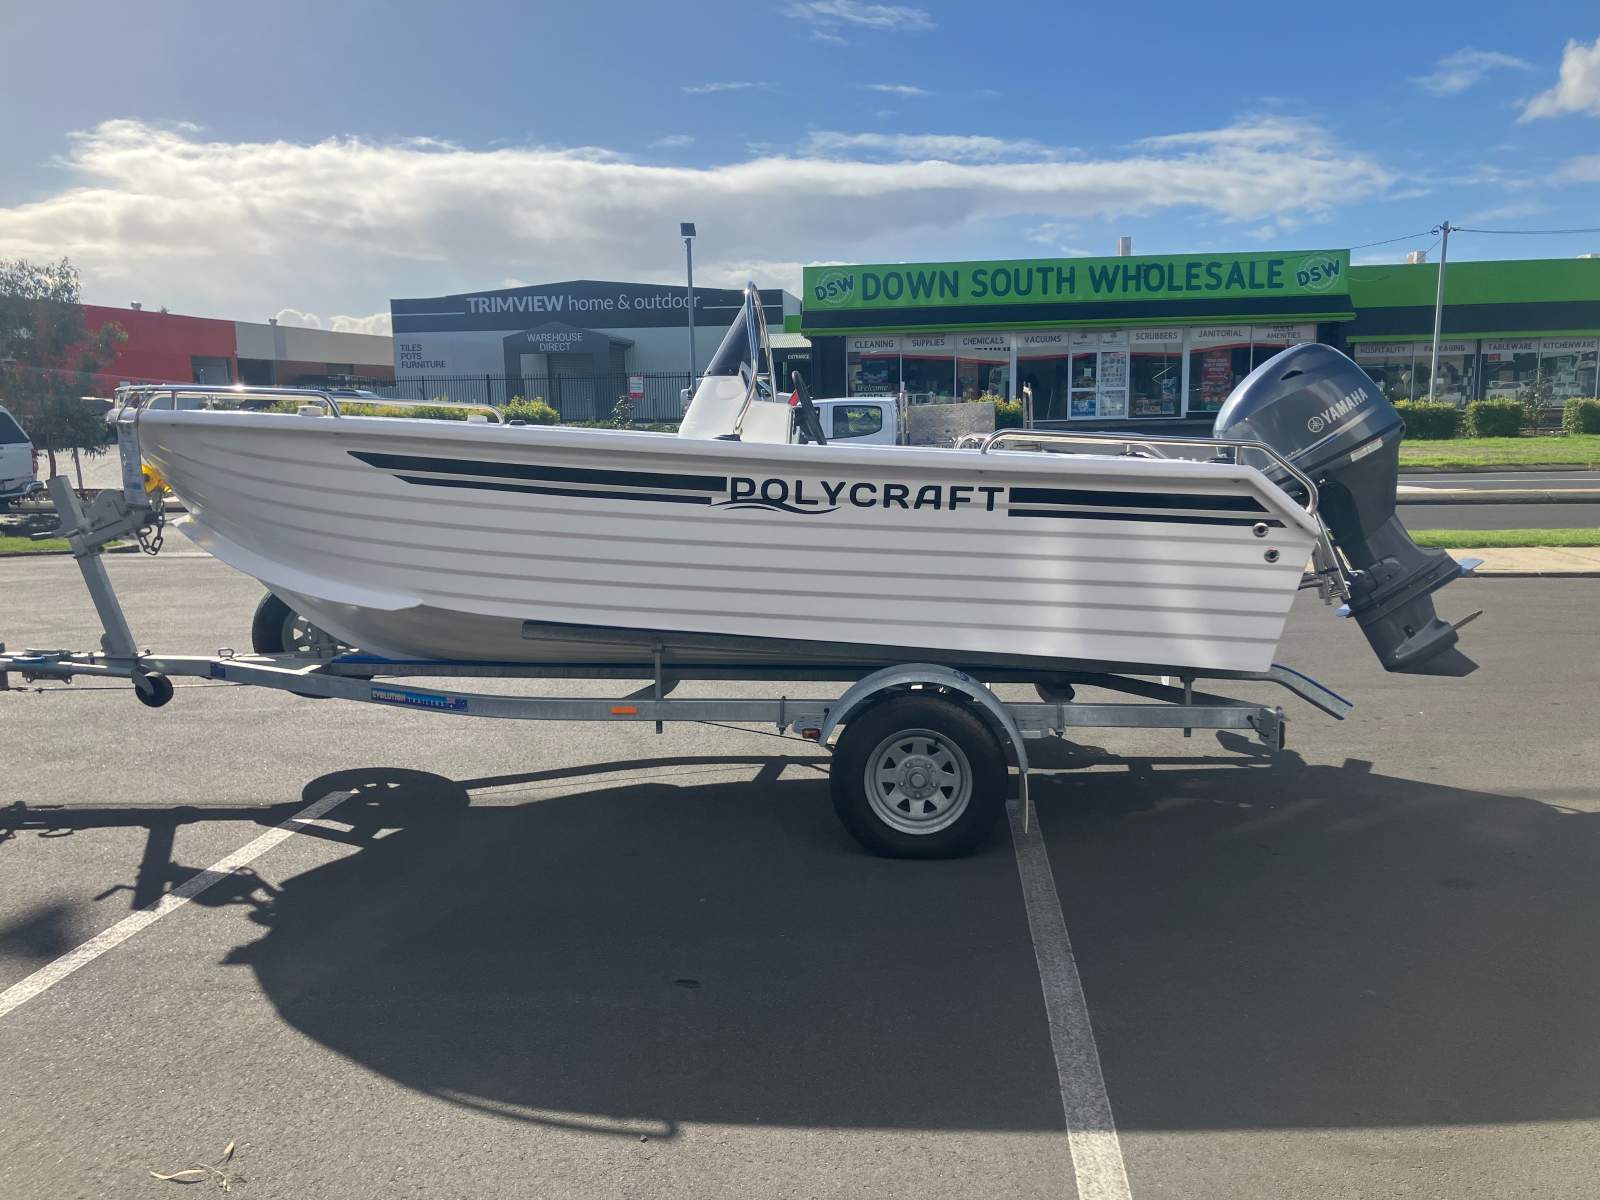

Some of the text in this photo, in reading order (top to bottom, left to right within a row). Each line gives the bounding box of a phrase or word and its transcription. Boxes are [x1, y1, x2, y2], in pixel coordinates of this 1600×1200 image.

[1296, 259, 1340, 287] DSW
[862, 260, 1285, 300] DOWN SOUTH WHOLESALE
[815, 275, 854, 301] DSW
[466, 293, 701, 313] TRIMVIEW home & outdoor
[527, 332, 583, 343] WAREHOUSE
[1135, 332, 1178, 340] SCRUBBERS
[1198, 330, 1243, 338] JANITORIAL
[912, 338, 945, 346] SUPPLIES
[962, 337, 1005, 345] CHEMICALS
[1024, 335, 1061, 343] VACUUMS
[539, 342, 571, 352] DIRECT
[854, 340, 894, 348] CLEANING
[1488, 343, 1533, 351] TABLEWARE
[1543, 341, 1596, 349] KITCHENWARE
[1360, 346, 1406, 354] HOSPITALITY
[402, 360, 446, 368] FURNITURE
[1320, 387, 1368, 424] YAMAHA
[730, 476, 1004, 512] POLYCRAFT
